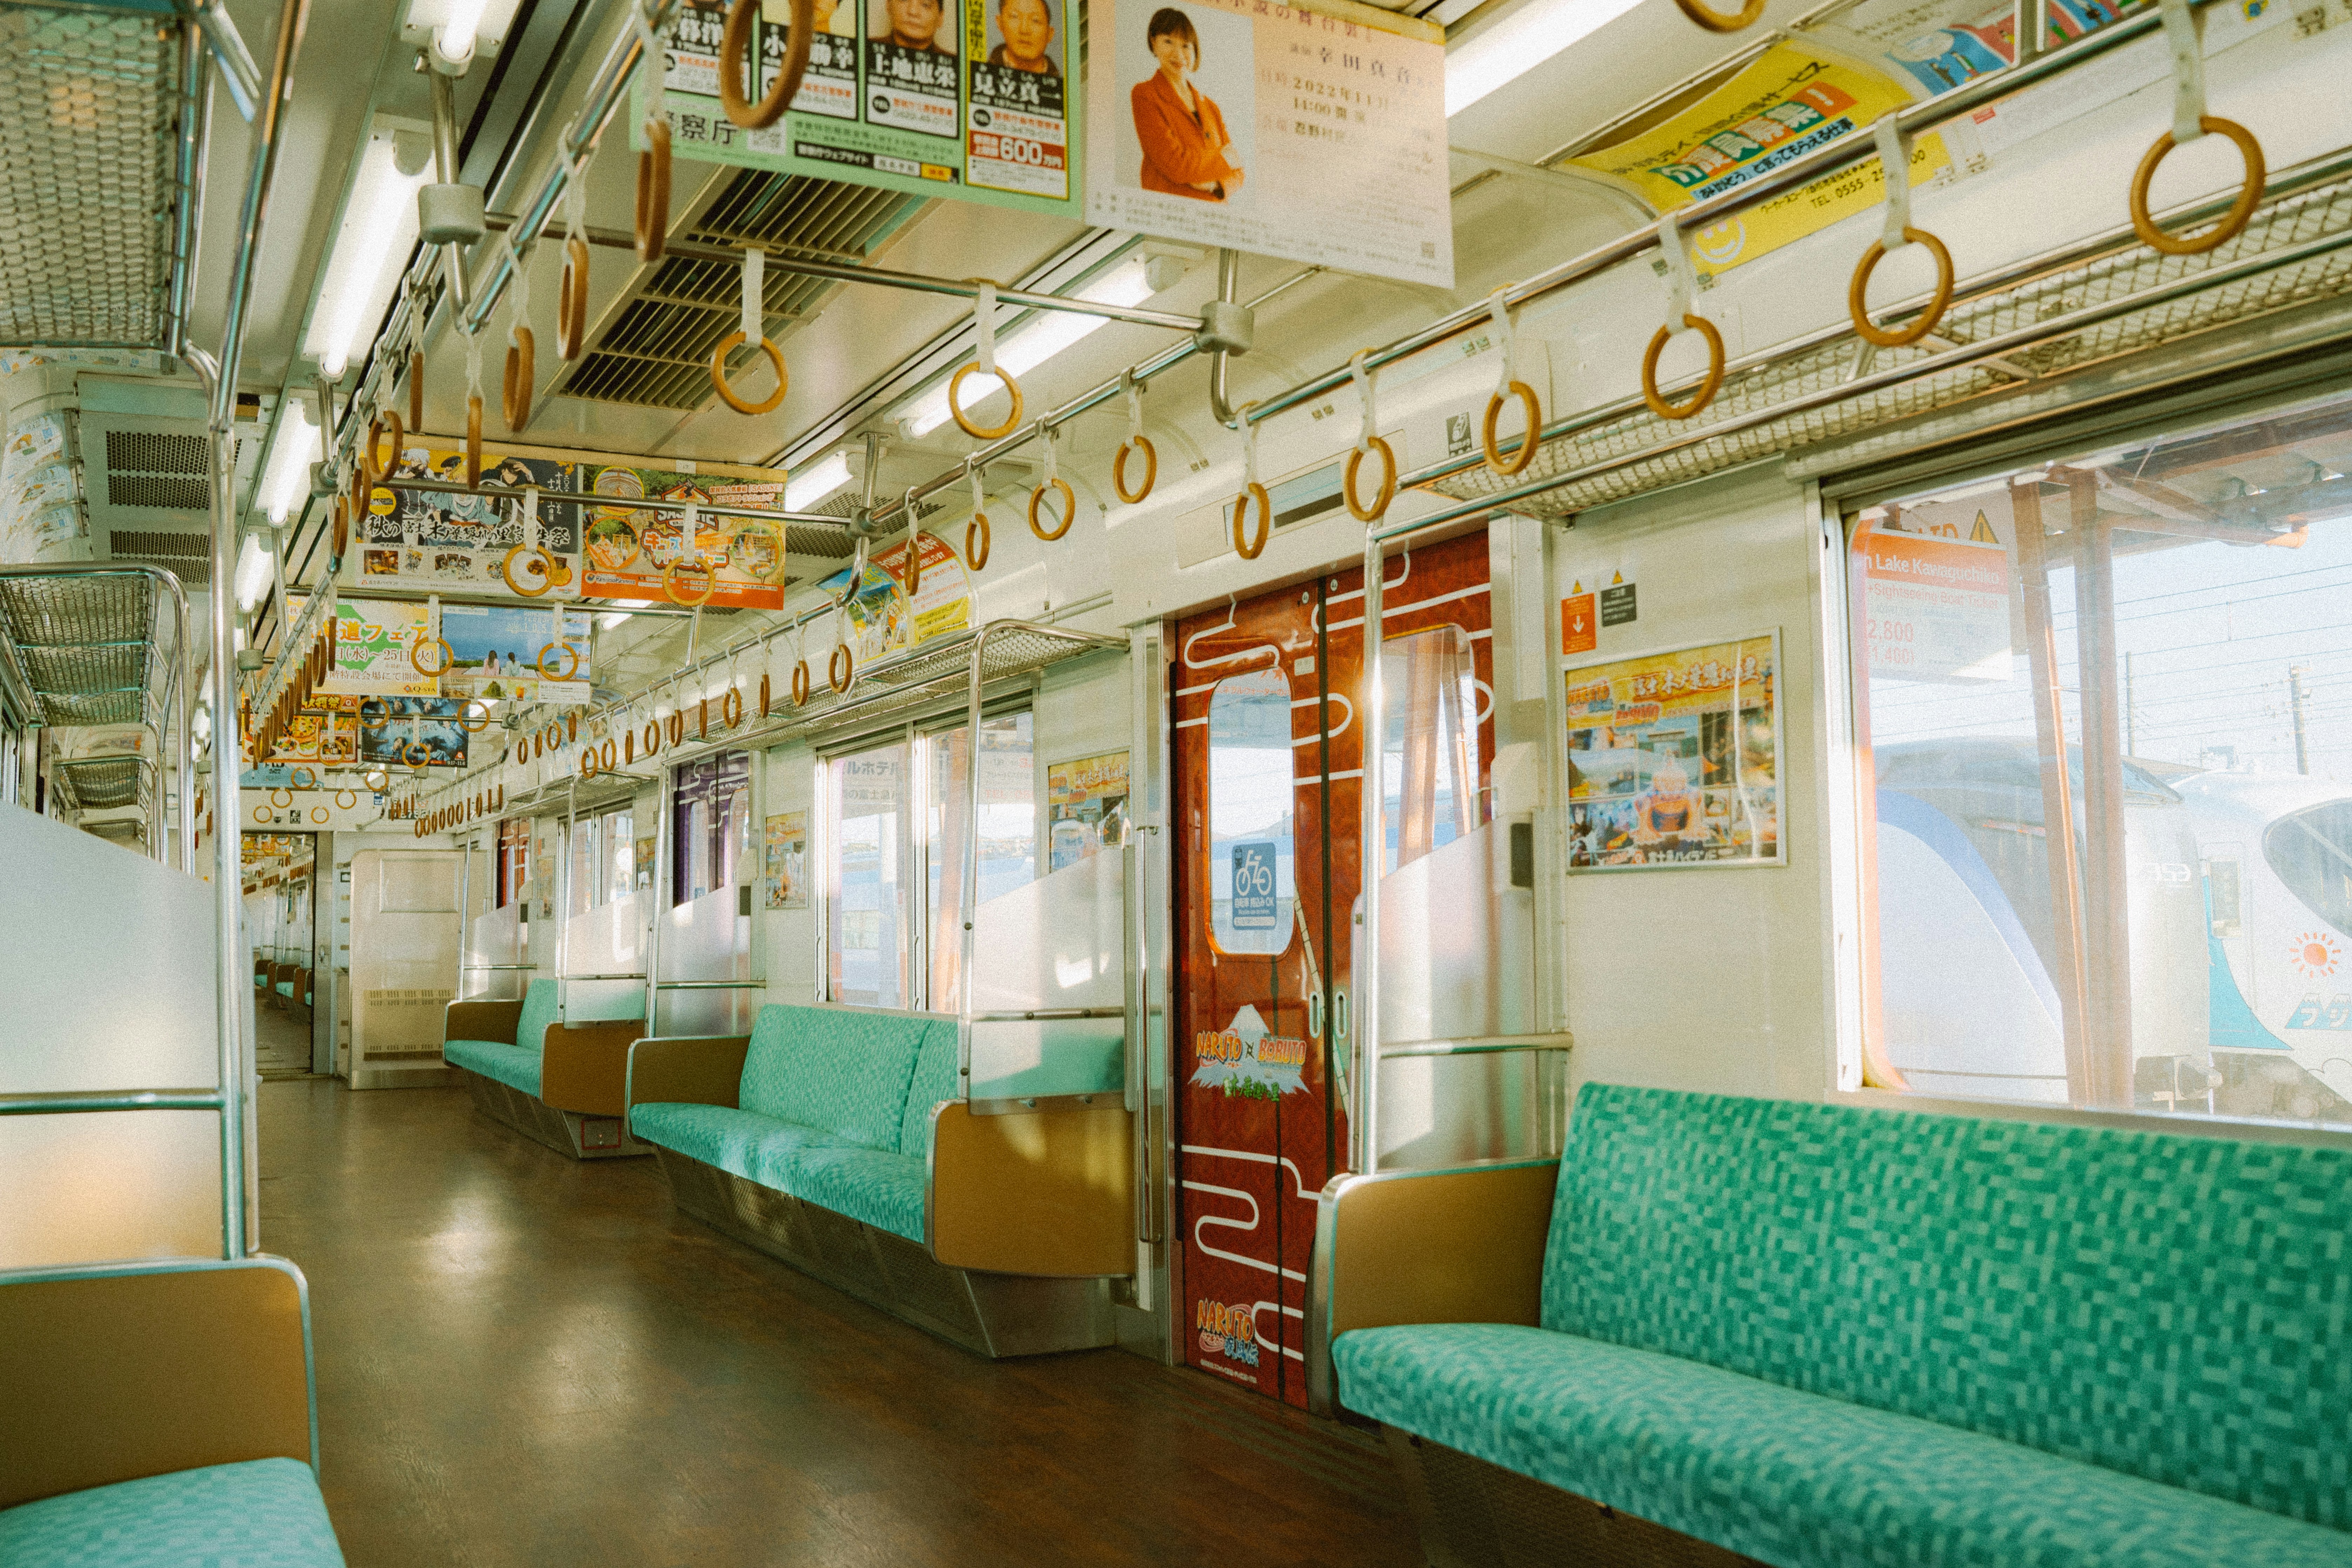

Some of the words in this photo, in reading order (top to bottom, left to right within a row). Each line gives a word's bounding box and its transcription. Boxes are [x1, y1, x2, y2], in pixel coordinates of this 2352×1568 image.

[1000, 136, 1062, 168] 600万円
[1811, 195, 1830, 209] TEL
[1876, 553, 1909, 573] Lake
[1913, 558, 2000, 585] Kawaguchiko
[1941, 591, 1964, 606] Boat
[1968, 594, 1999, 609] Ticket
[323, 620, 428, 643] 道フェア
[986, 789, 1007, 799] TEL
[1196, 1031, 1243, 1064] NARUTO
[1258, 1038, 1307, 1066] BORUTO
[1197, 1297, 1255, 1344] NARUTO
